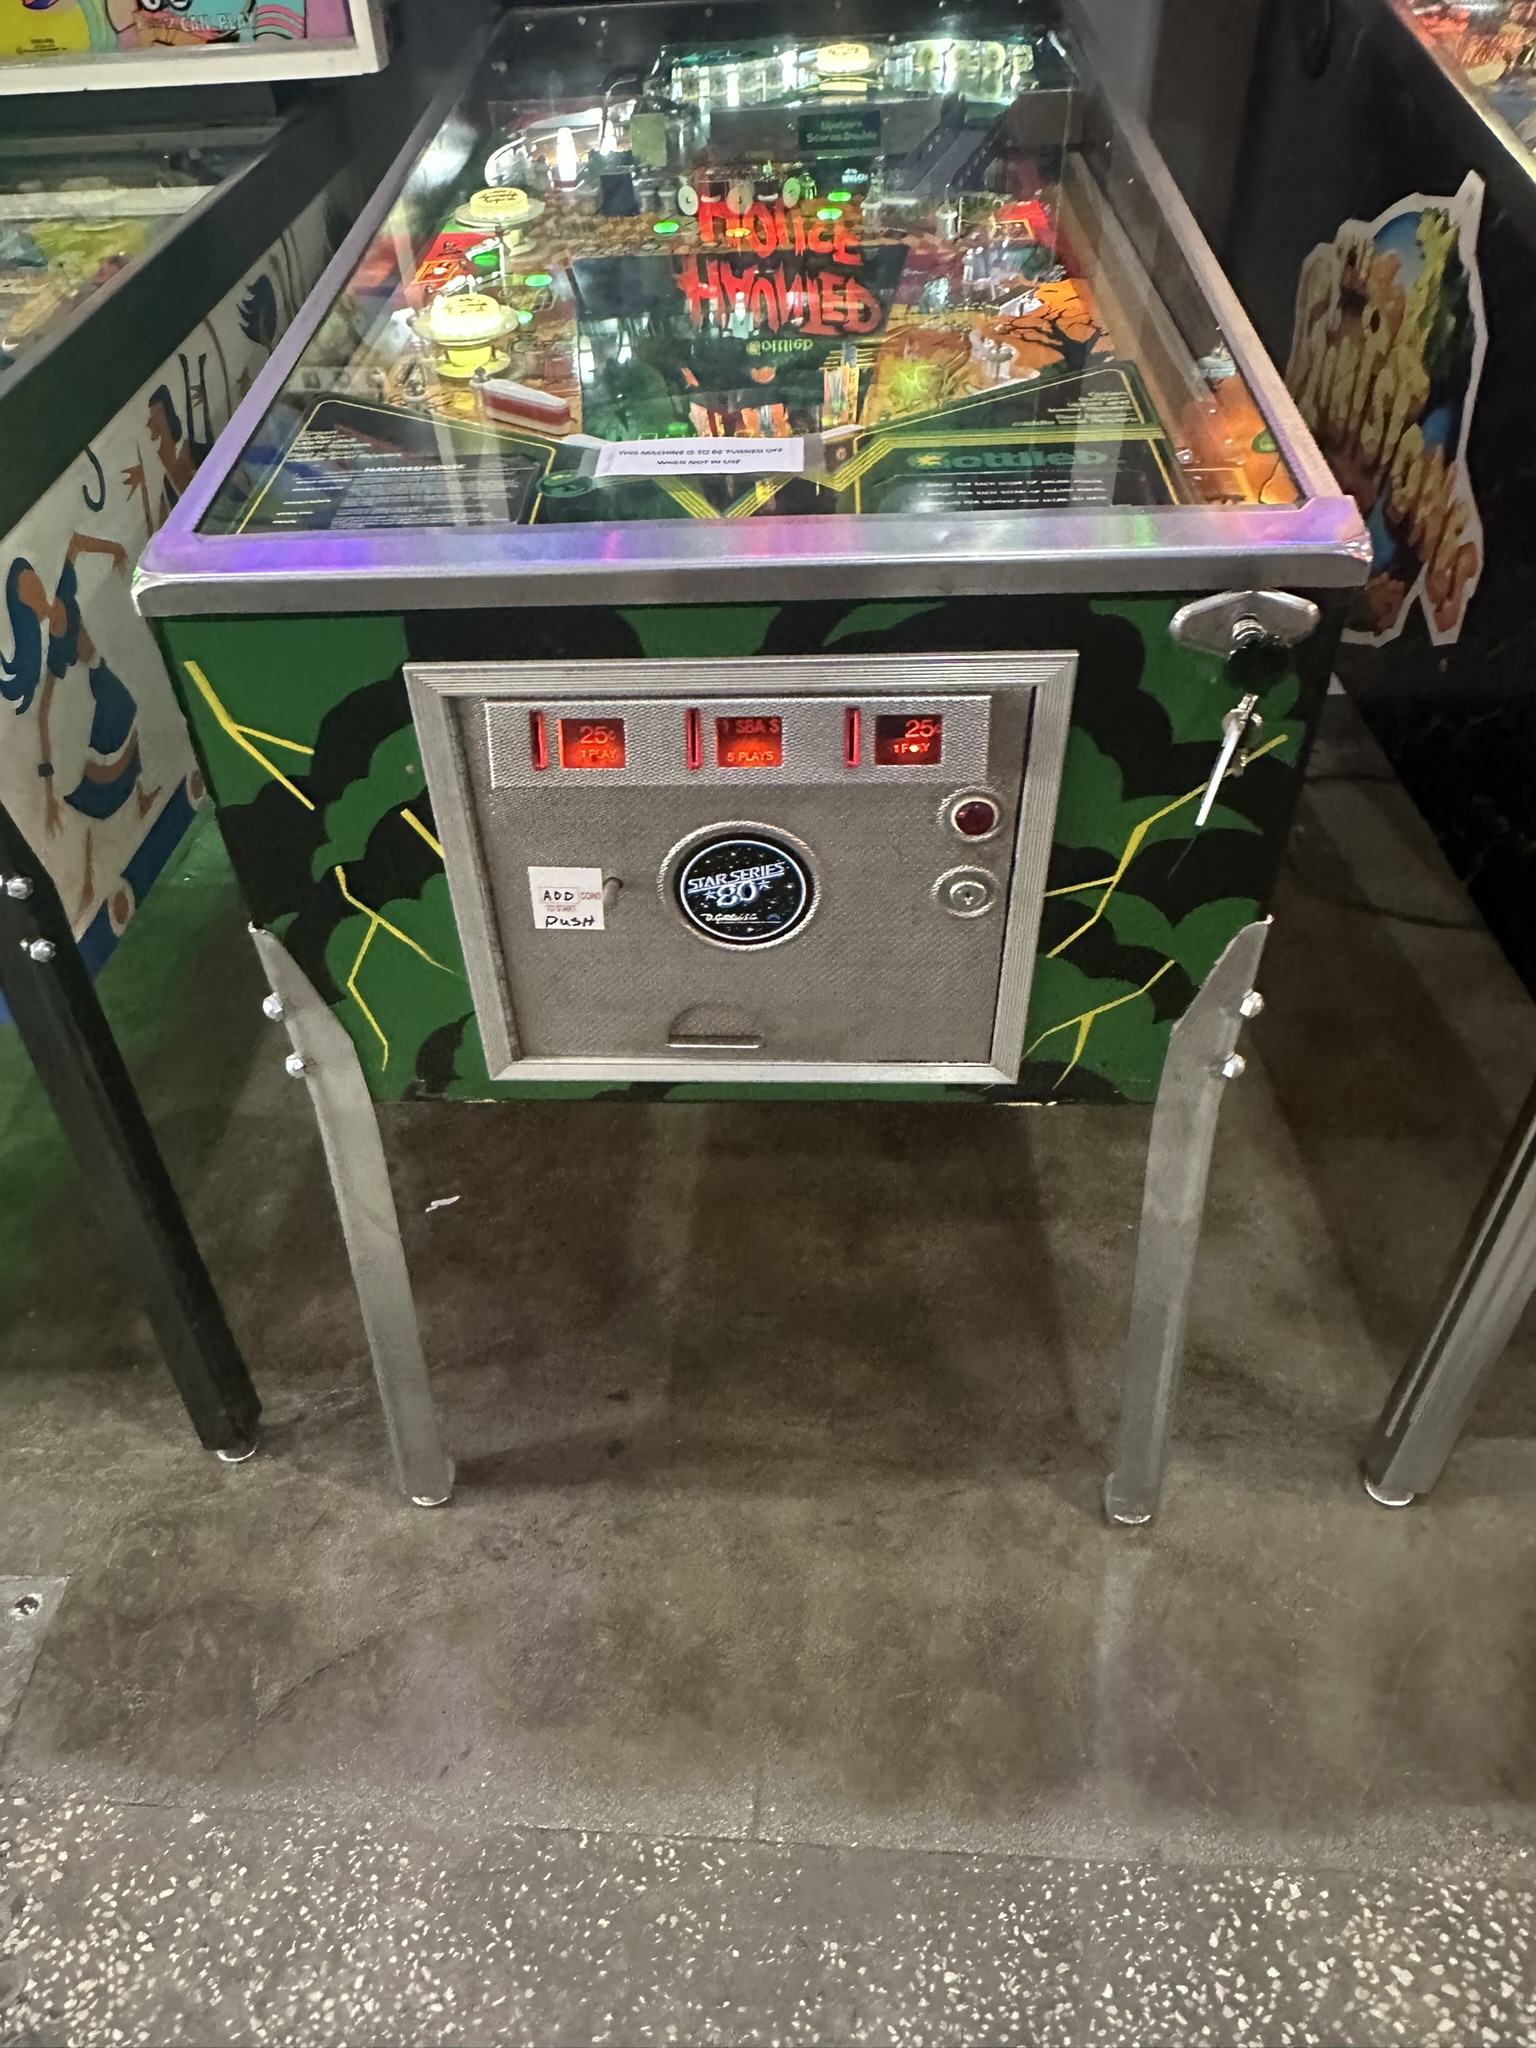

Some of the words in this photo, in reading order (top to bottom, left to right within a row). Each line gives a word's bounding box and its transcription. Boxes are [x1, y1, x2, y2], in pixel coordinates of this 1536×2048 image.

[589, 749, 617, 759] PLAY
[727, 752, 735, 762] 5
[738, 751, 775, 762] PLAYS
[688, 873, 728, 890] STAR
[729, 861, 786, 884] SERIES
[543, 890, 574, 901] ADD
[716, 880, 759, 908] 80
